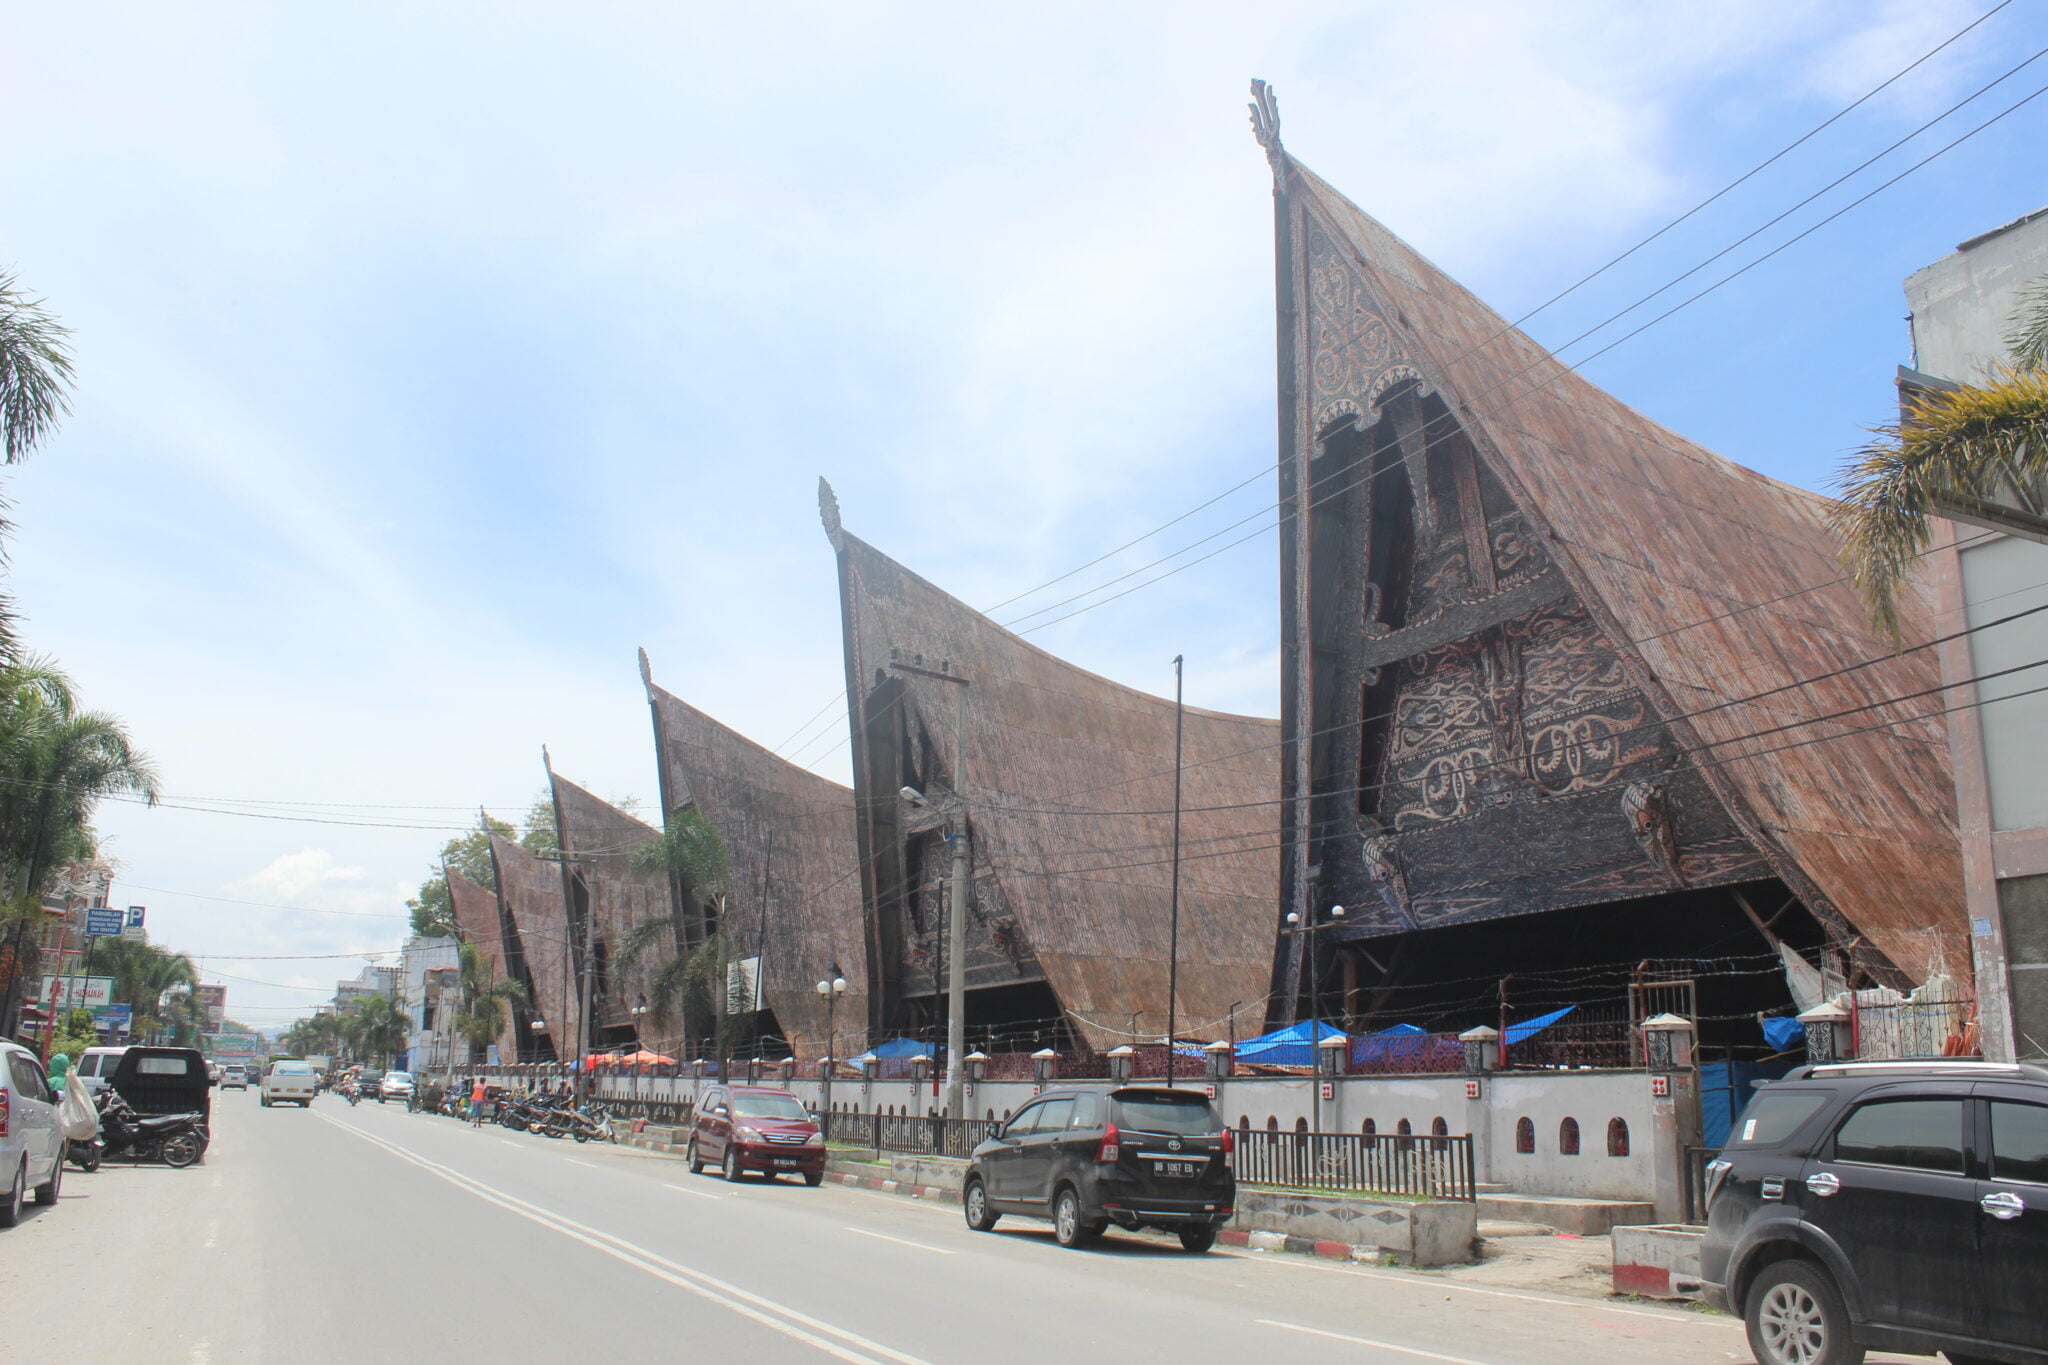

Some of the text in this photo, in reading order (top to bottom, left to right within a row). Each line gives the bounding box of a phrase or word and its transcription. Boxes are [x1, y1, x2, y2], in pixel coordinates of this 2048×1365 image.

[130, 908, 143, 924] P
[1155, 1162, 1163, 1171] BB
[1167, 1163, 1181, 1172] 1067
[1184, 1164, 1193, 1173] ED
